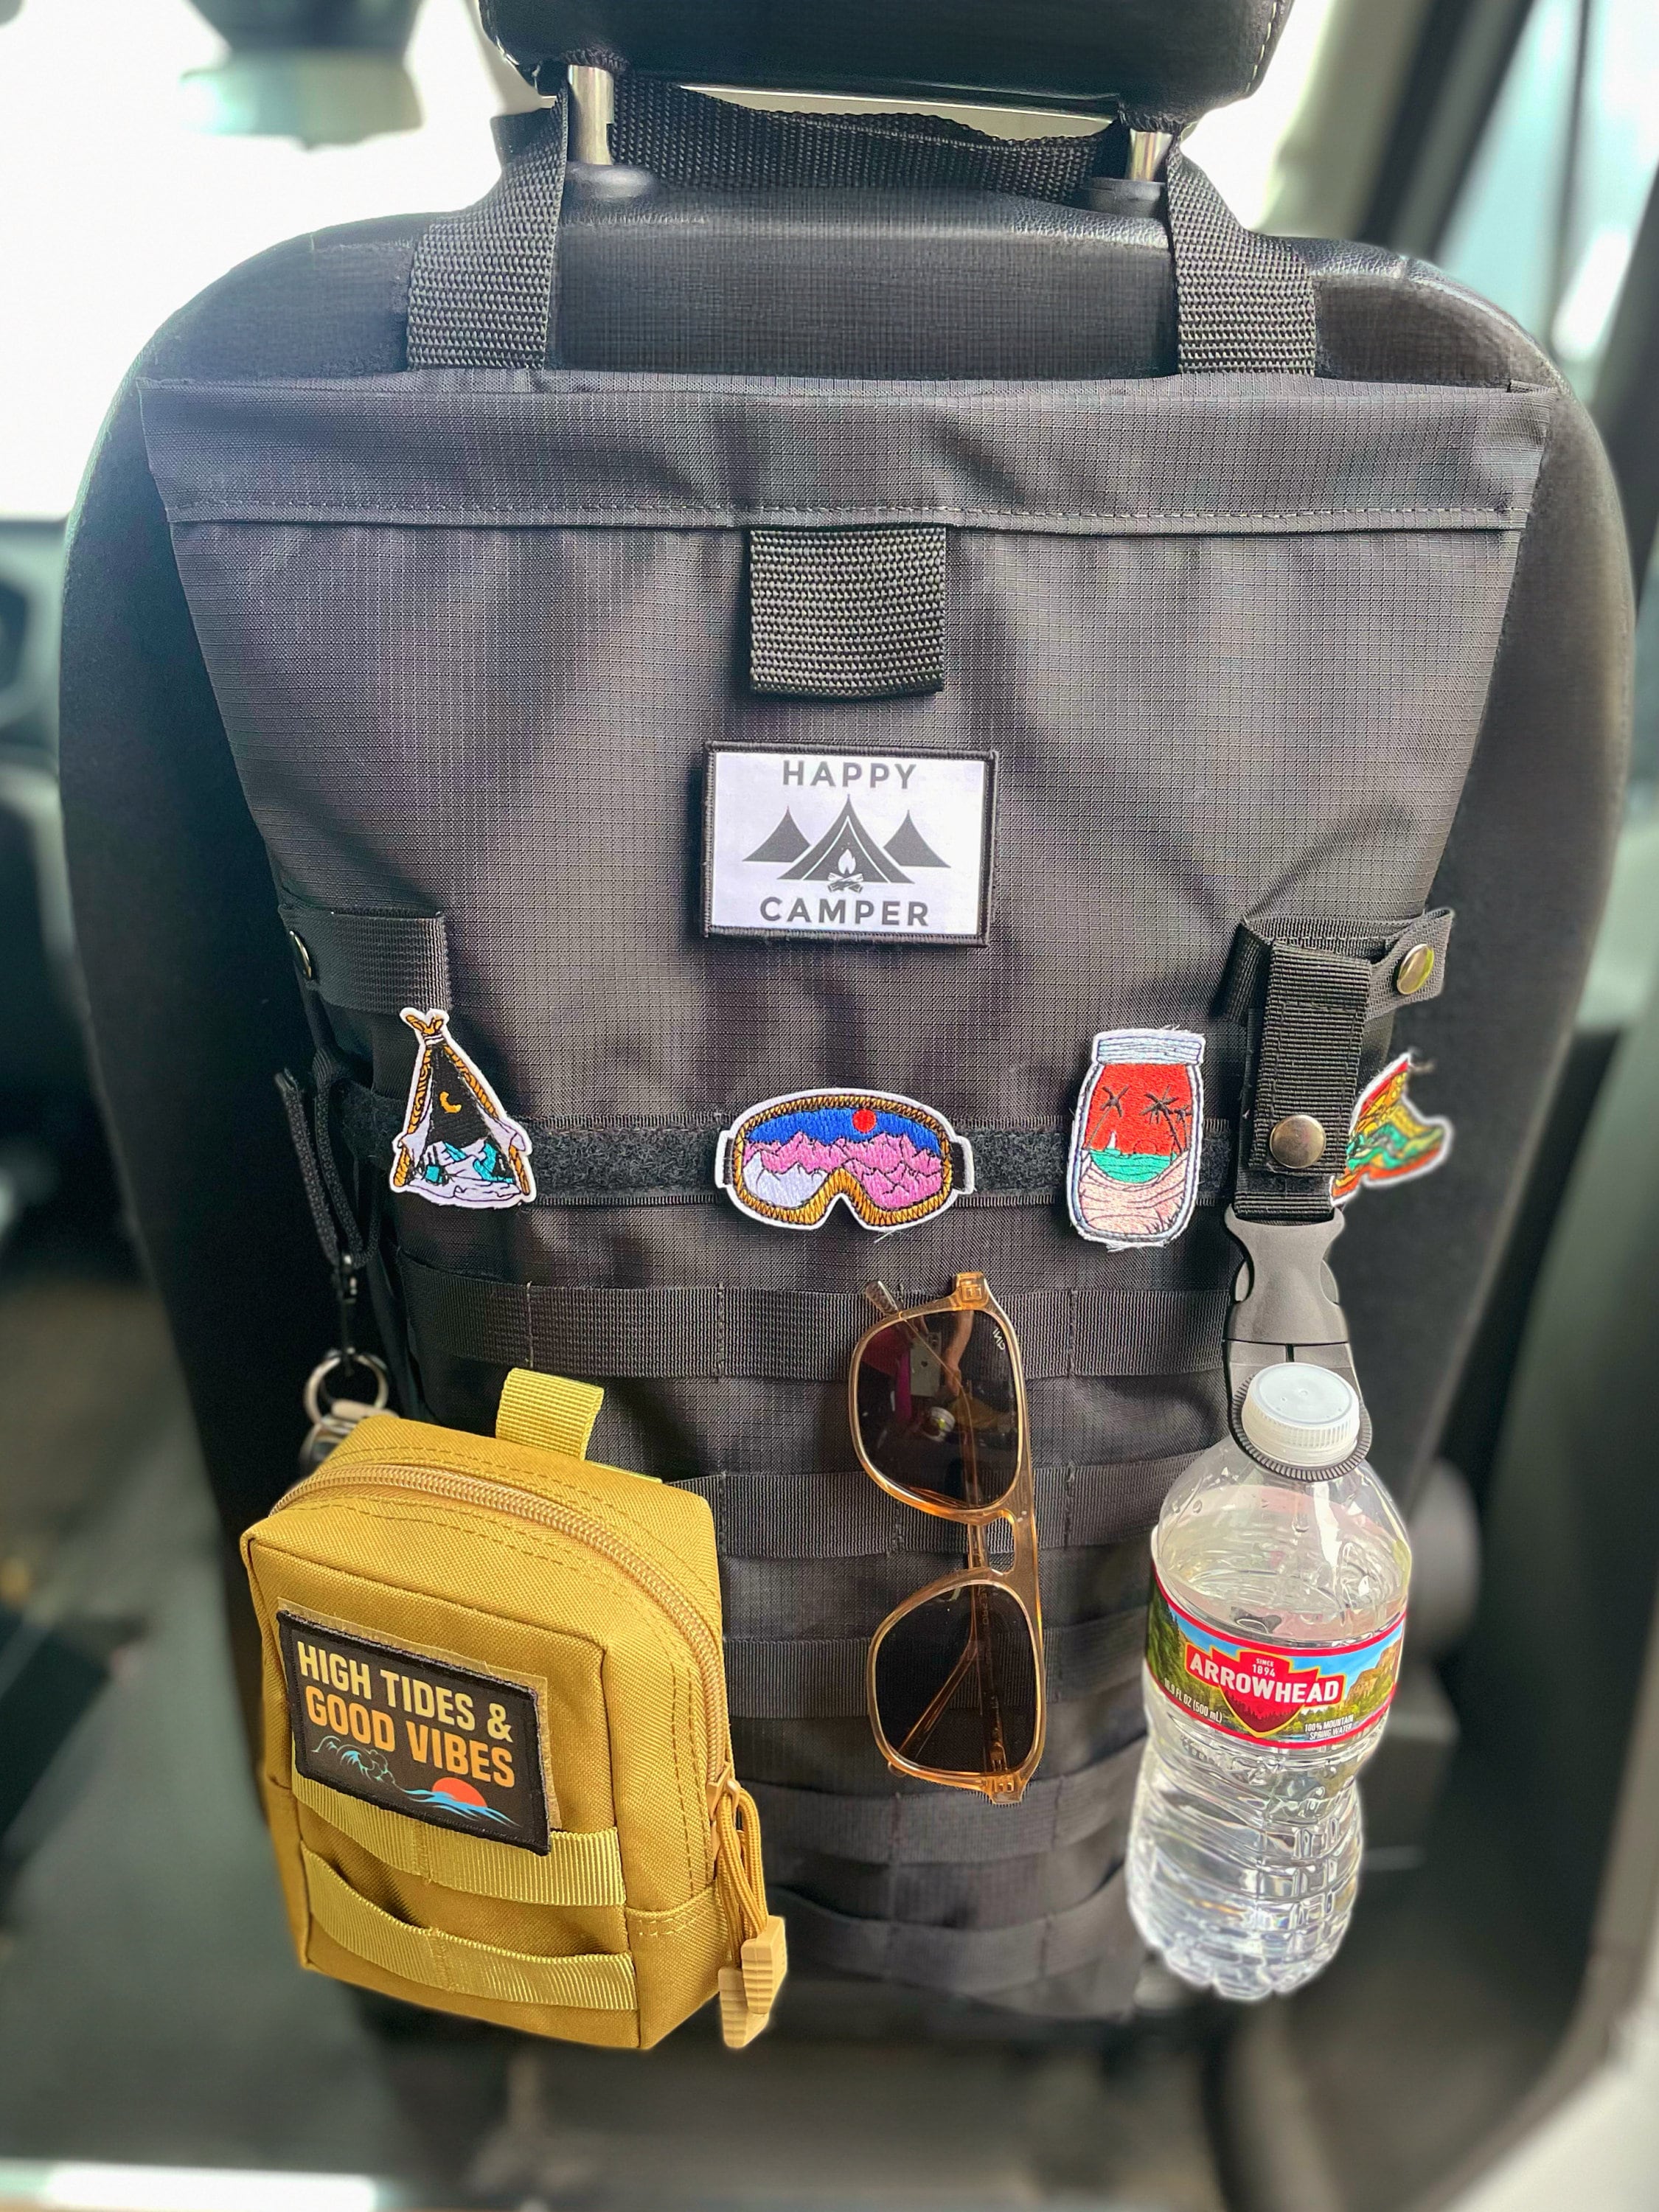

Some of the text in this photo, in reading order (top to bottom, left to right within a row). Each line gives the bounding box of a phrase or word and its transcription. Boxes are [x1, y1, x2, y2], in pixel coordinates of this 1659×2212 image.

[782, 760, 917, 789] HAPPY
[759, 897, 928, 927] CAMPER
[1253, 1664, 1276, 1677] 1894
[1256, 1658, 1274, 1667] SINCE
[297, 1641, 514, 1743] HIGH TIDES &
[1189, 1652, 1340, 1704] ARROWHEAD
[1176, 1688, 1182, 1702] FL
[1183, 1694, 1192, 1708] OZ
[1193, 1700, 1208, 1717] (500
[305, 1686, 515, 1788] GOOD VIBES
[1305, 1714, 1354, 1732] 100% MOUNTAIN
[1310, 1722, 1353, 1740] SPRING WATER
